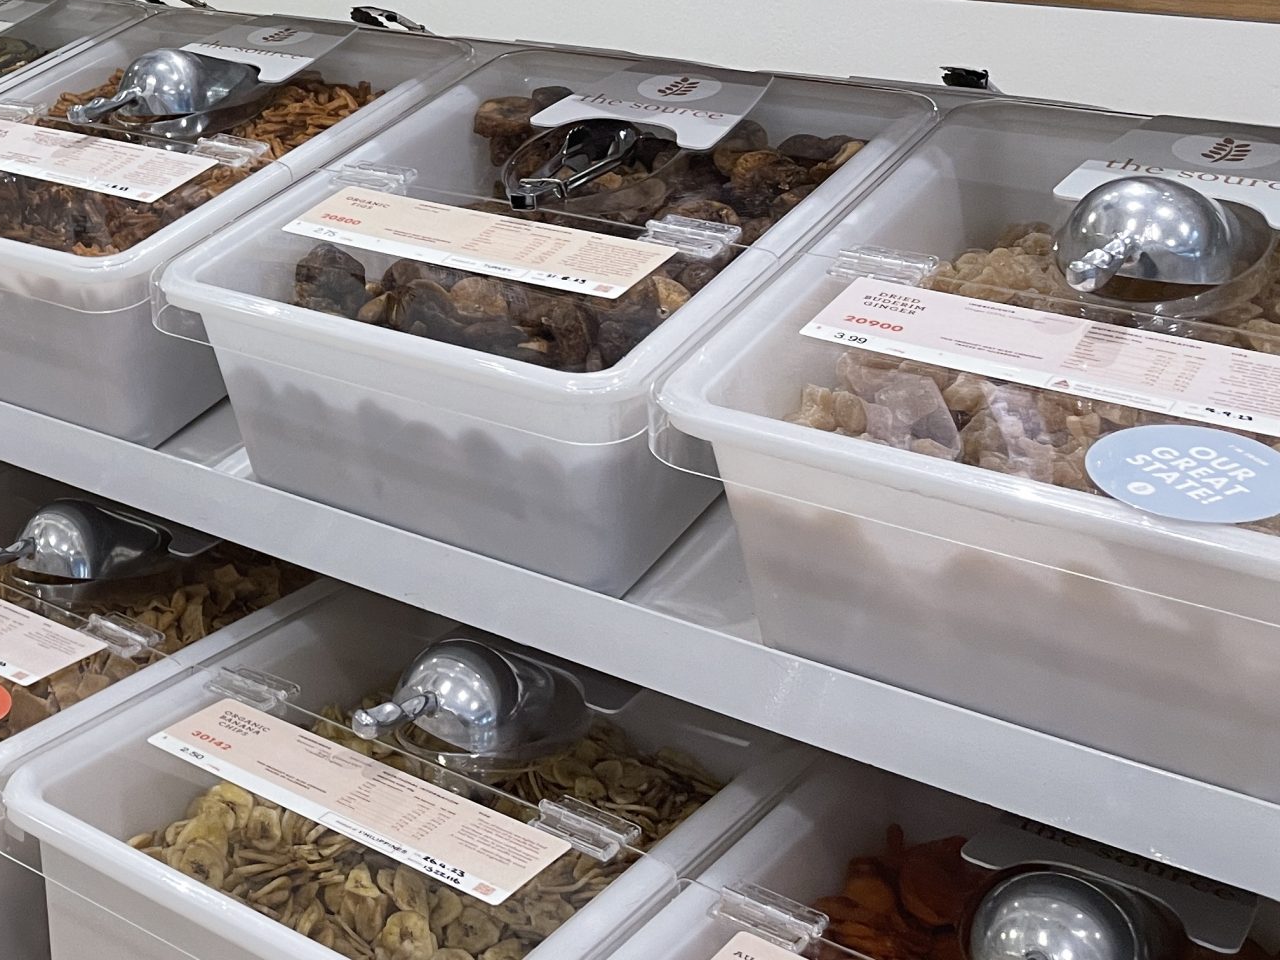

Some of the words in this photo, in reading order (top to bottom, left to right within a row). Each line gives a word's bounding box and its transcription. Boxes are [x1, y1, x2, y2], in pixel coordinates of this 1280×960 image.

[198, 40, 232, 54] the
[234, 45, 308, 60] source
[579, 92, 622, 107] the
[629, 101, 725, 121] source
[1104, 157, 1165, 176] the
[345, 196, 391, 209] ORGANIC
[350, 202, 375, 210] FIGS
[320, 213, 363, 226] 20800
[862, 295, 927, 312] BUDERIM
[878, 291, 922, 304] DRIED
[862, 301, 918, 317] GINGER
[843, 315, 905, 333] 20900
[833, 331, 869, 345] 3.99
[1151, 446, 1252, 495] GREAT
[1187, 446, 1257, 482] OUR
[1124, 453, 1225, 505] STATE!
[217, 721, 250, 737] CHIPS
[218, 714, 261, 736] BANANA
[223, 710, 271, 733] ORGANIC
[191, 729, 233, 752] 30142
[179, 746, 206, 760] 2.50
[357, 829, 408, 855] PHILIPPINES
